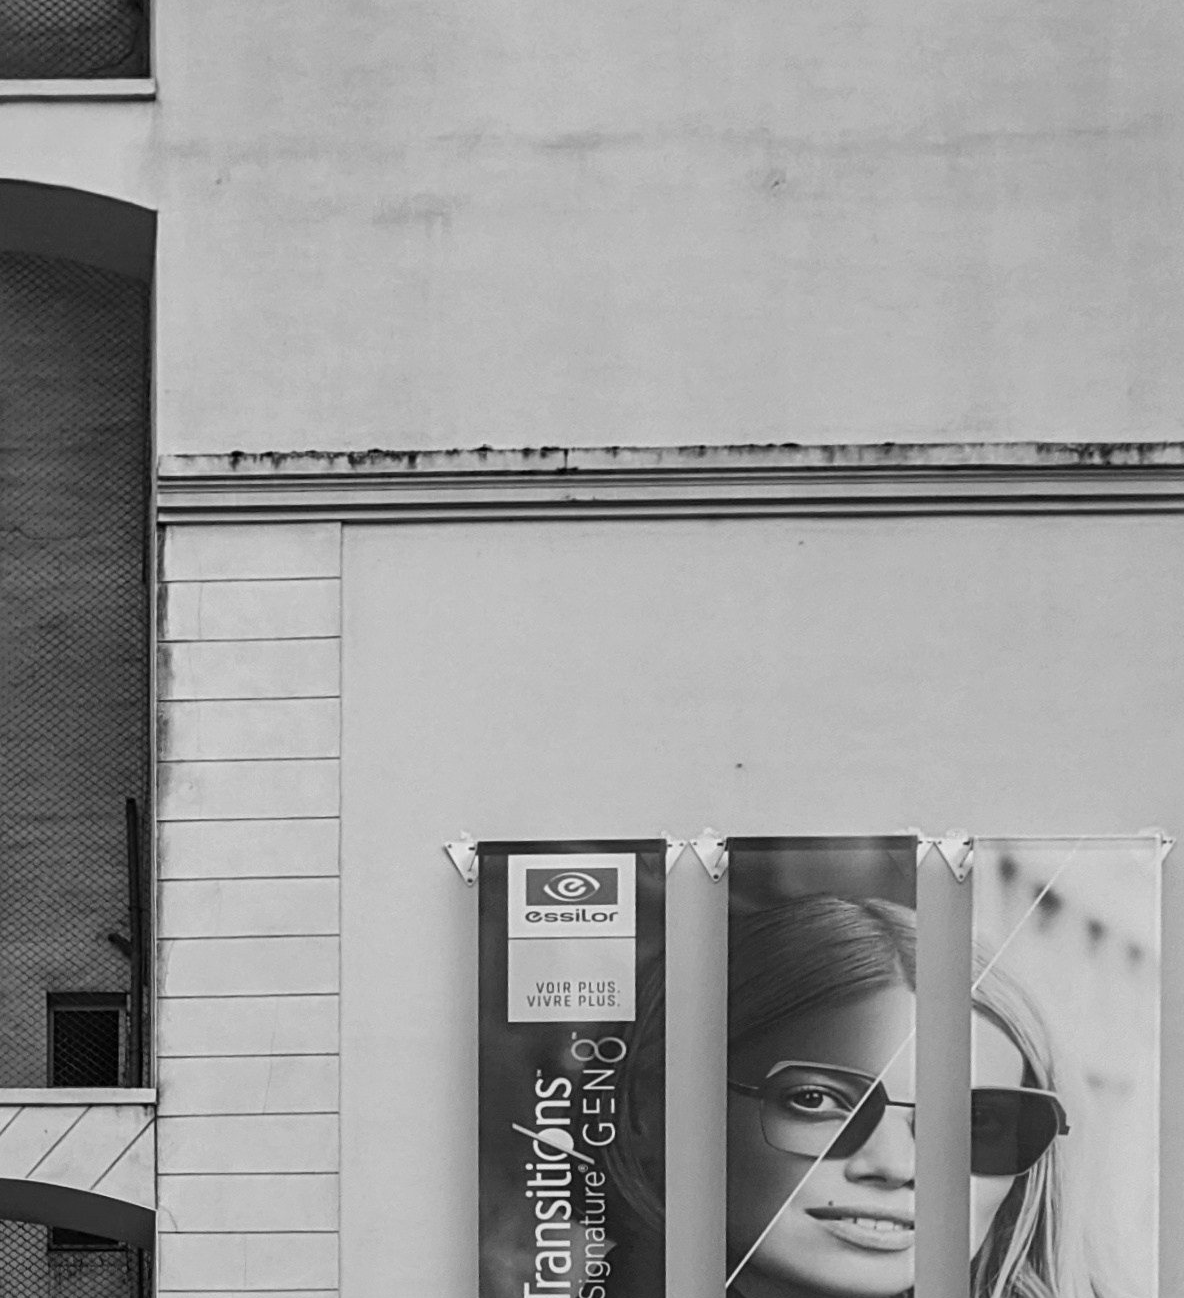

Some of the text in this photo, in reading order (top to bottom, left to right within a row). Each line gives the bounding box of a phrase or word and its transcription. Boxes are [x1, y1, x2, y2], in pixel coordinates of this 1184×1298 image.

[524, 908, 619, 924] essilor
[535, 980, 621, 994] VOIR PLUS.
[526, 994, 621, 1008] VIVRE PLUS.
[570, 1034, 627, 1147] GEN8
